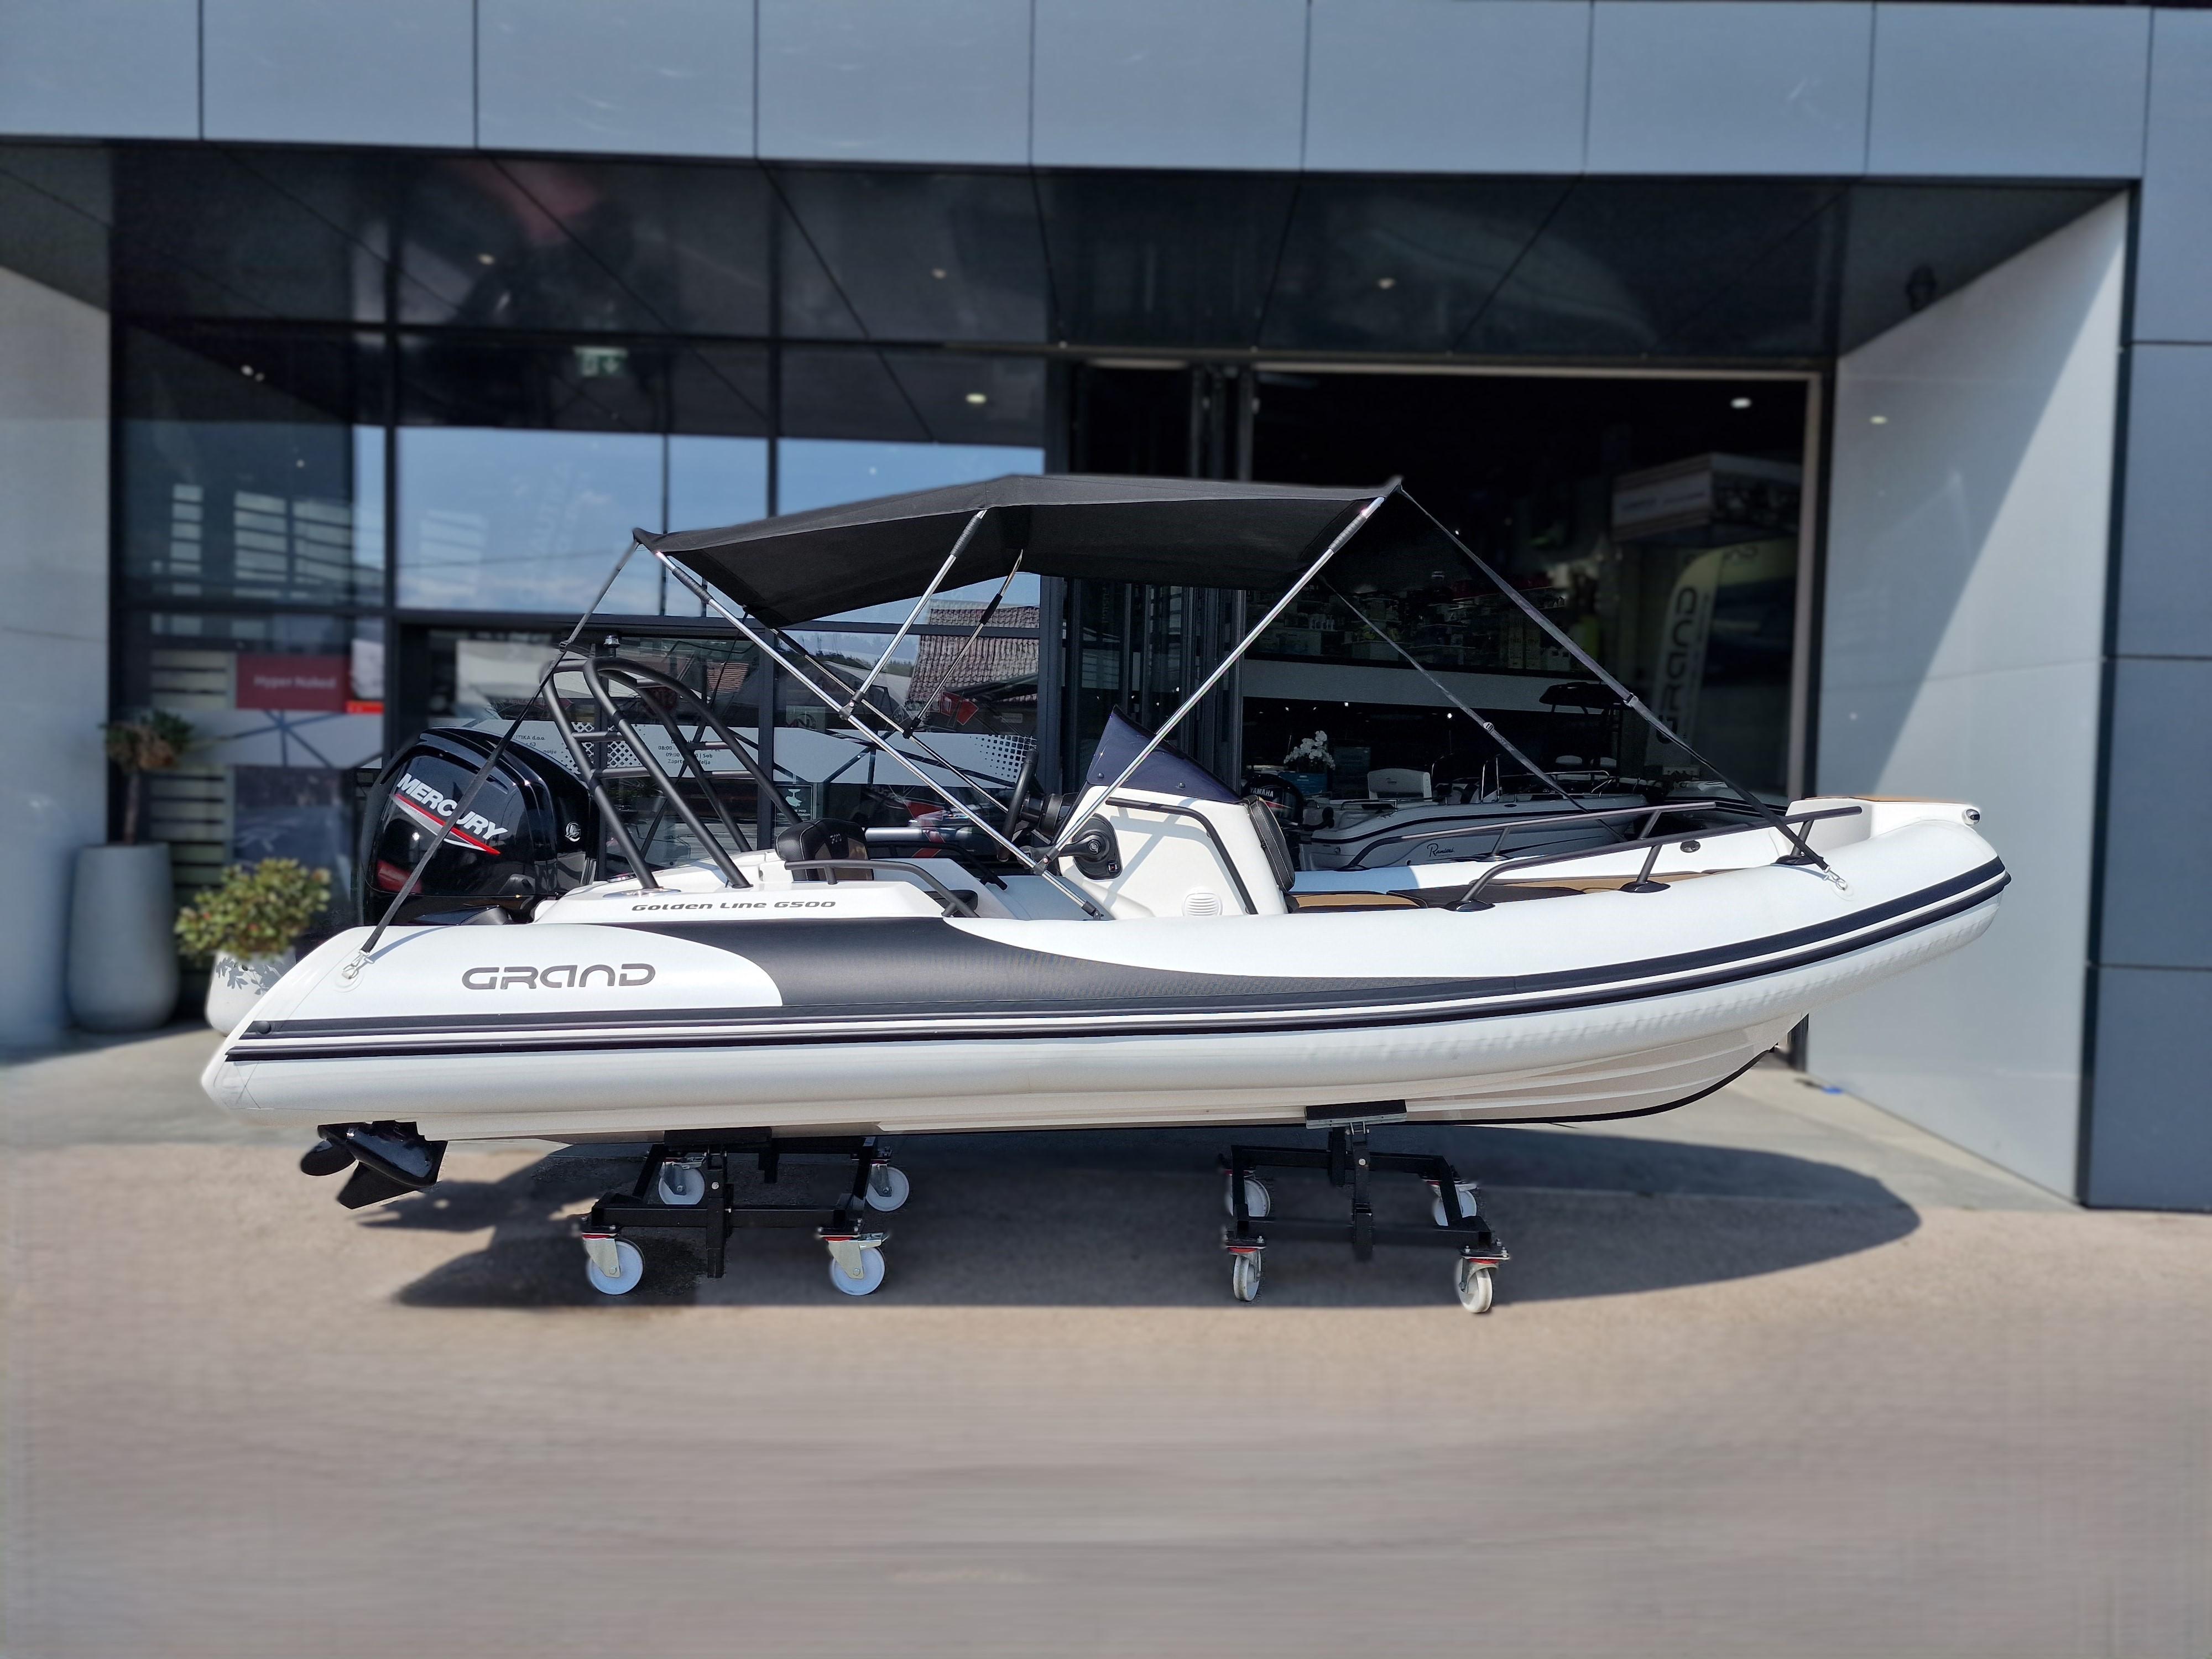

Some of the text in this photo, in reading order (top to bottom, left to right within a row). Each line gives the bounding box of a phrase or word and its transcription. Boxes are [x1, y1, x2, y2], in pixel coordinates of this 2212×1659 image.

[1250, 786, 1274, 798] YAMAHA
[397, 773, 508, 840] MERCURY
[631, 903, 713, 911] Golden
[462, 963, 655, 990] GRAND
